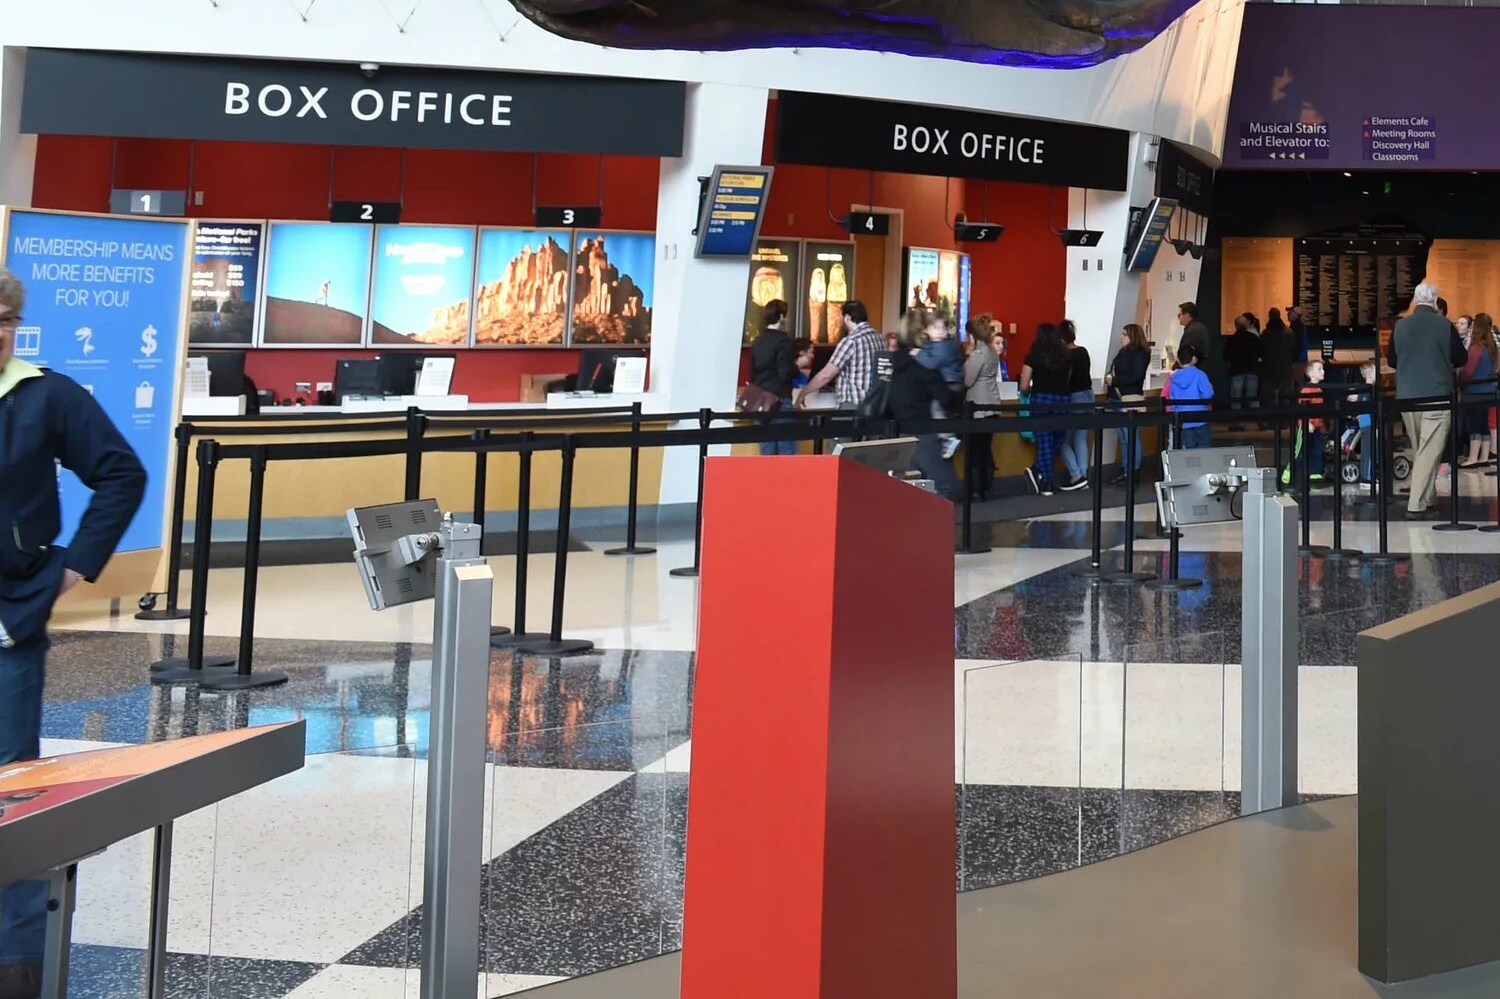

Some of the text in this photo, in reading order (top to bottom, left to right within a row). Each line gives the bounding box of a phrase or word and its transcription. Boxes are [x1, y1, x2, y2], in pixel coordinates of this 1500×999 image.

[224, 82, 513, 126] BOX OFFICE
[1249, 122, 1327, 134] Musical Stairs
[1371, 116, 1429, 126] Elements Cafe
[1240, 135, 1330, 148] and Elevator to:
[1372, 129, 1436, 139] Meeting Rooms
[892, 124, 1045, 164] BOX OFFICE
[1372, 140, 1430, 151] Discovery Hall
[1372, 152, 1419, 161] Classrooms
[140, 194, 150, 211] 1
[360, 204, 373, 220] 2
[562, 209, 574, 224] 3
[865, 215, 874, 231] 4
[976, 228, 988, 240] 5
[1079, 233, 1090, 245] 6
[14, 237, 174, 262] MEMBERSHIP MEANS
[32, 263, 155, 284] MORE BENEFITS
[55, 288, 130, 307] FOR YOU!
